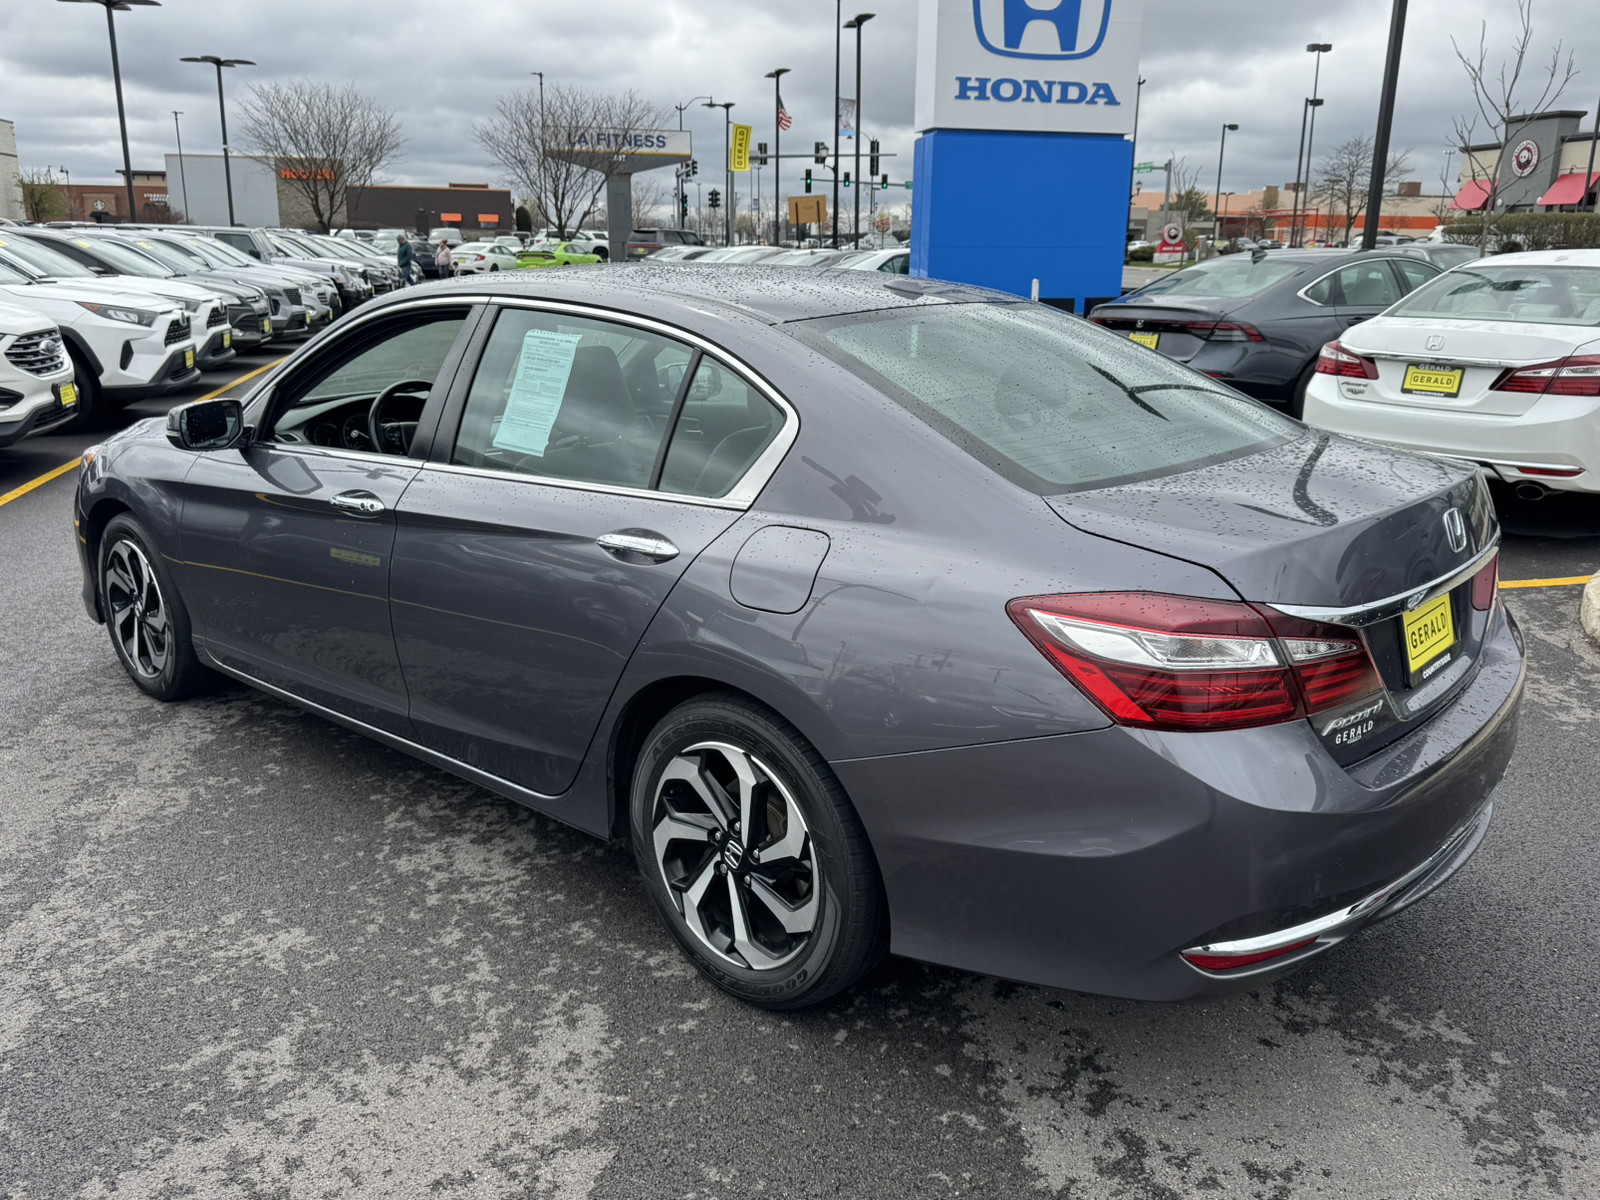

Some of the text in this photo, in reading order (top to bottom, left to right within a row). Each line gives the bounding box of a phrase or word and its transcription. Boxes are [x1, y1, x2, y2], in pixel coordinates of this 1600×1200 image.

[955, 76, 1121, 106] HONDA
[597, 132, 667, 149] FITNESS
[736, 130, 745, 166] GERALD
[1412, 374, 1453, 386] GERALD
[1419, 363, 1451, 372] GERALD
[1410, 612, 1447, 649] GERALD
[1422, 652, 1452, 680] COUNTRYSIDE
[1321, 699, 1384, 737] Accord
[1335, 720, 1374, 745] GERALD
